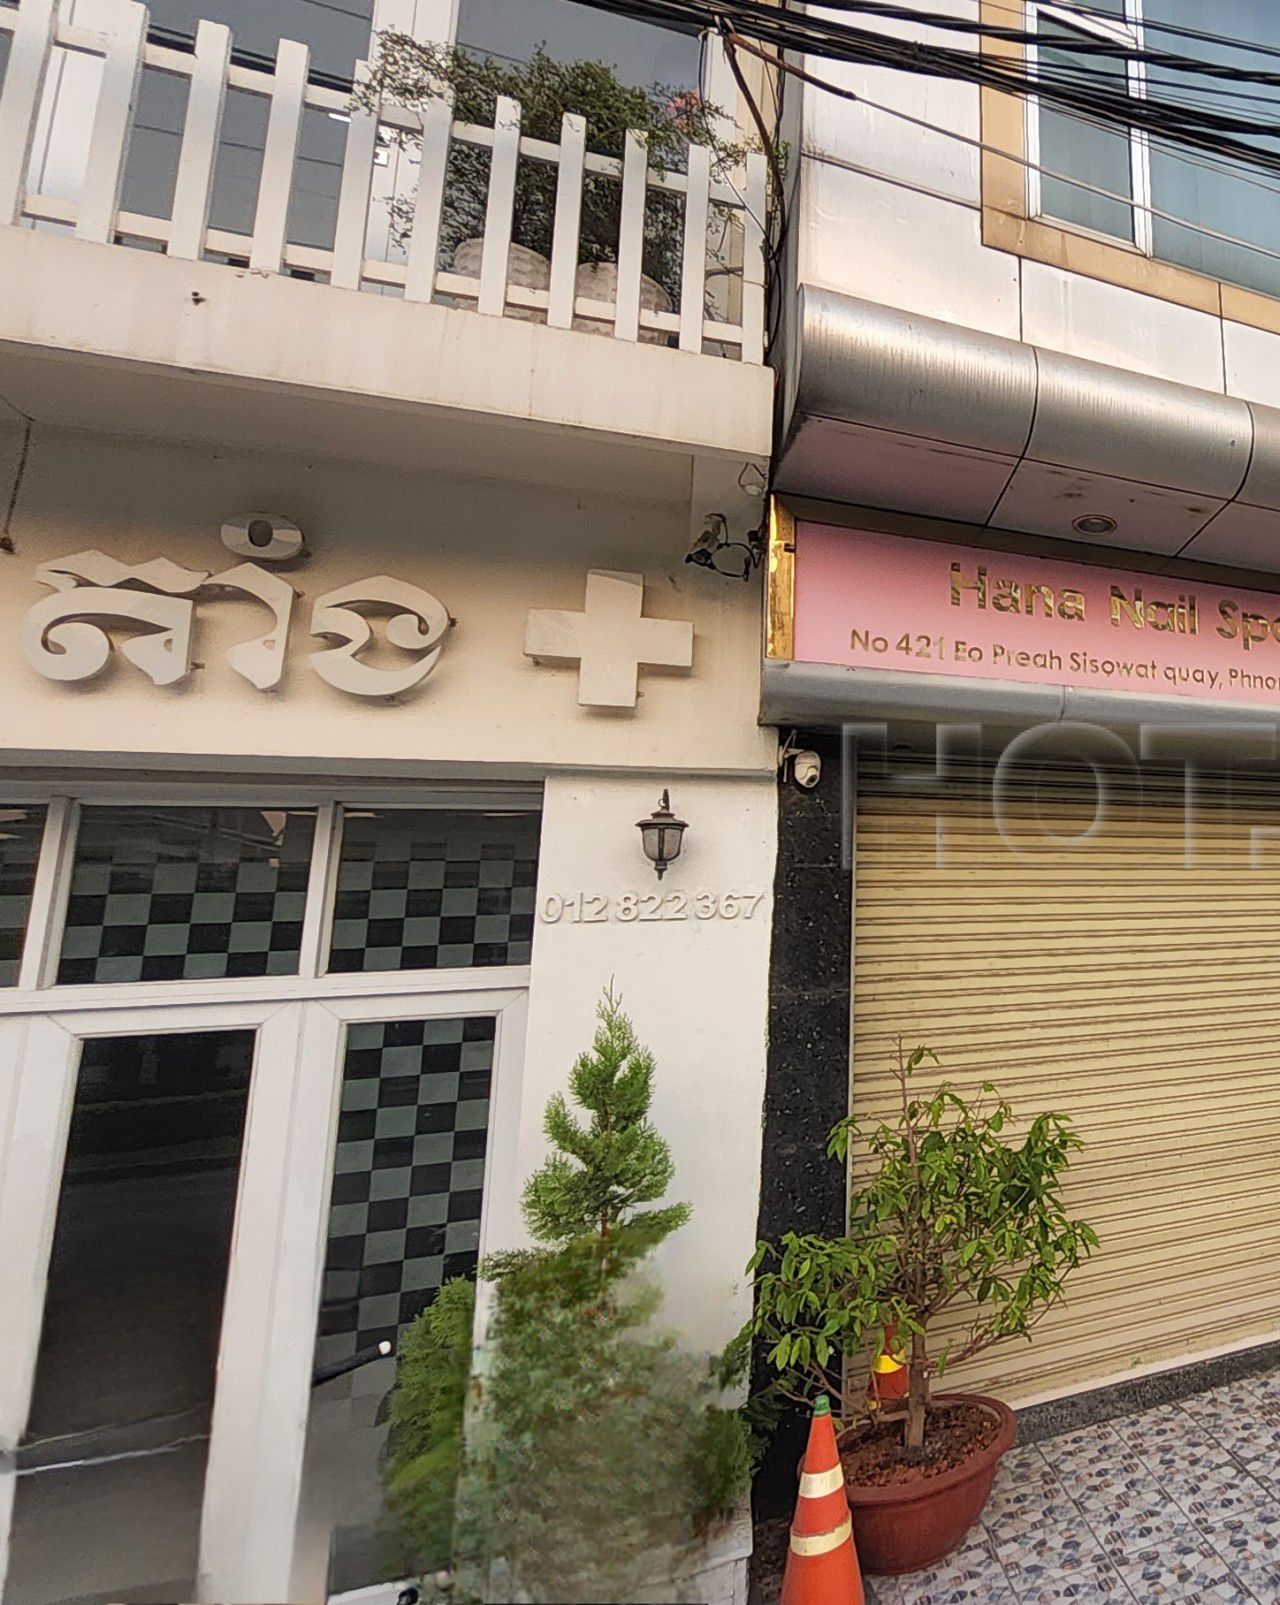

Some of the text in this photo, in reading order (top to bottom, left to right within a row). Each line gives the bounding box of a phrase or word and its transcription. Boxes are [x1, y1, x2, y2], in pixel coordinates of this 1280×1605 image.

[950, 562, 1086, 621] Hana
[1110, 584, 1198, 635] Nail
[850, 629, 889, 653] No
[895, 633, 945, 660] 421
[992, 643, 1062, 672] Preah
[1069, 651, 1158, 680] Sisowat
[538, 889, 767, 923] 012 822 367
